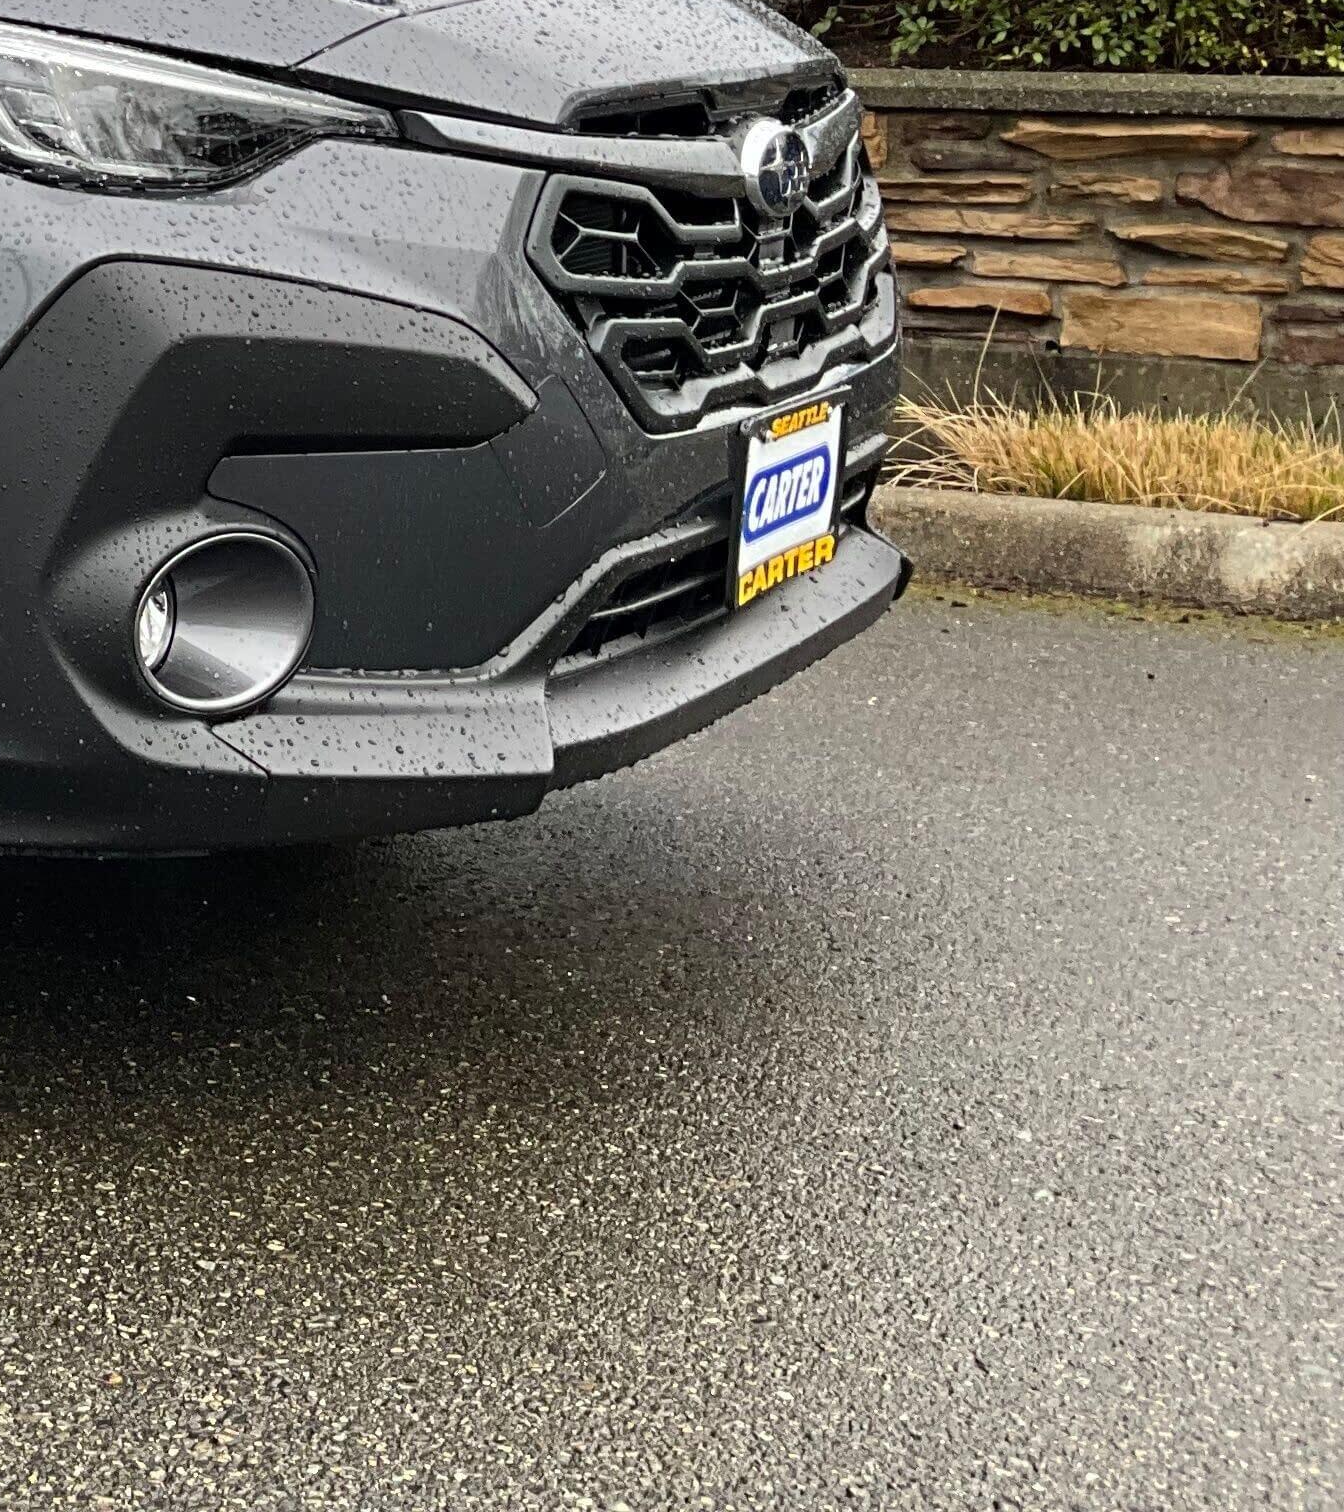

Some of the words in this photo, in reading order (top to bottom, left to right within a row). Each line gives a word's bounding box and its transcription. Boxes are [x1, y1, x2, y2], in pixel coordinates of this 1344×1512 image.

[771, 401, 830, 438] SEATTLE
[747, 455, 826, 533] CARTER
[738, 534, 836, 607] CARTER
